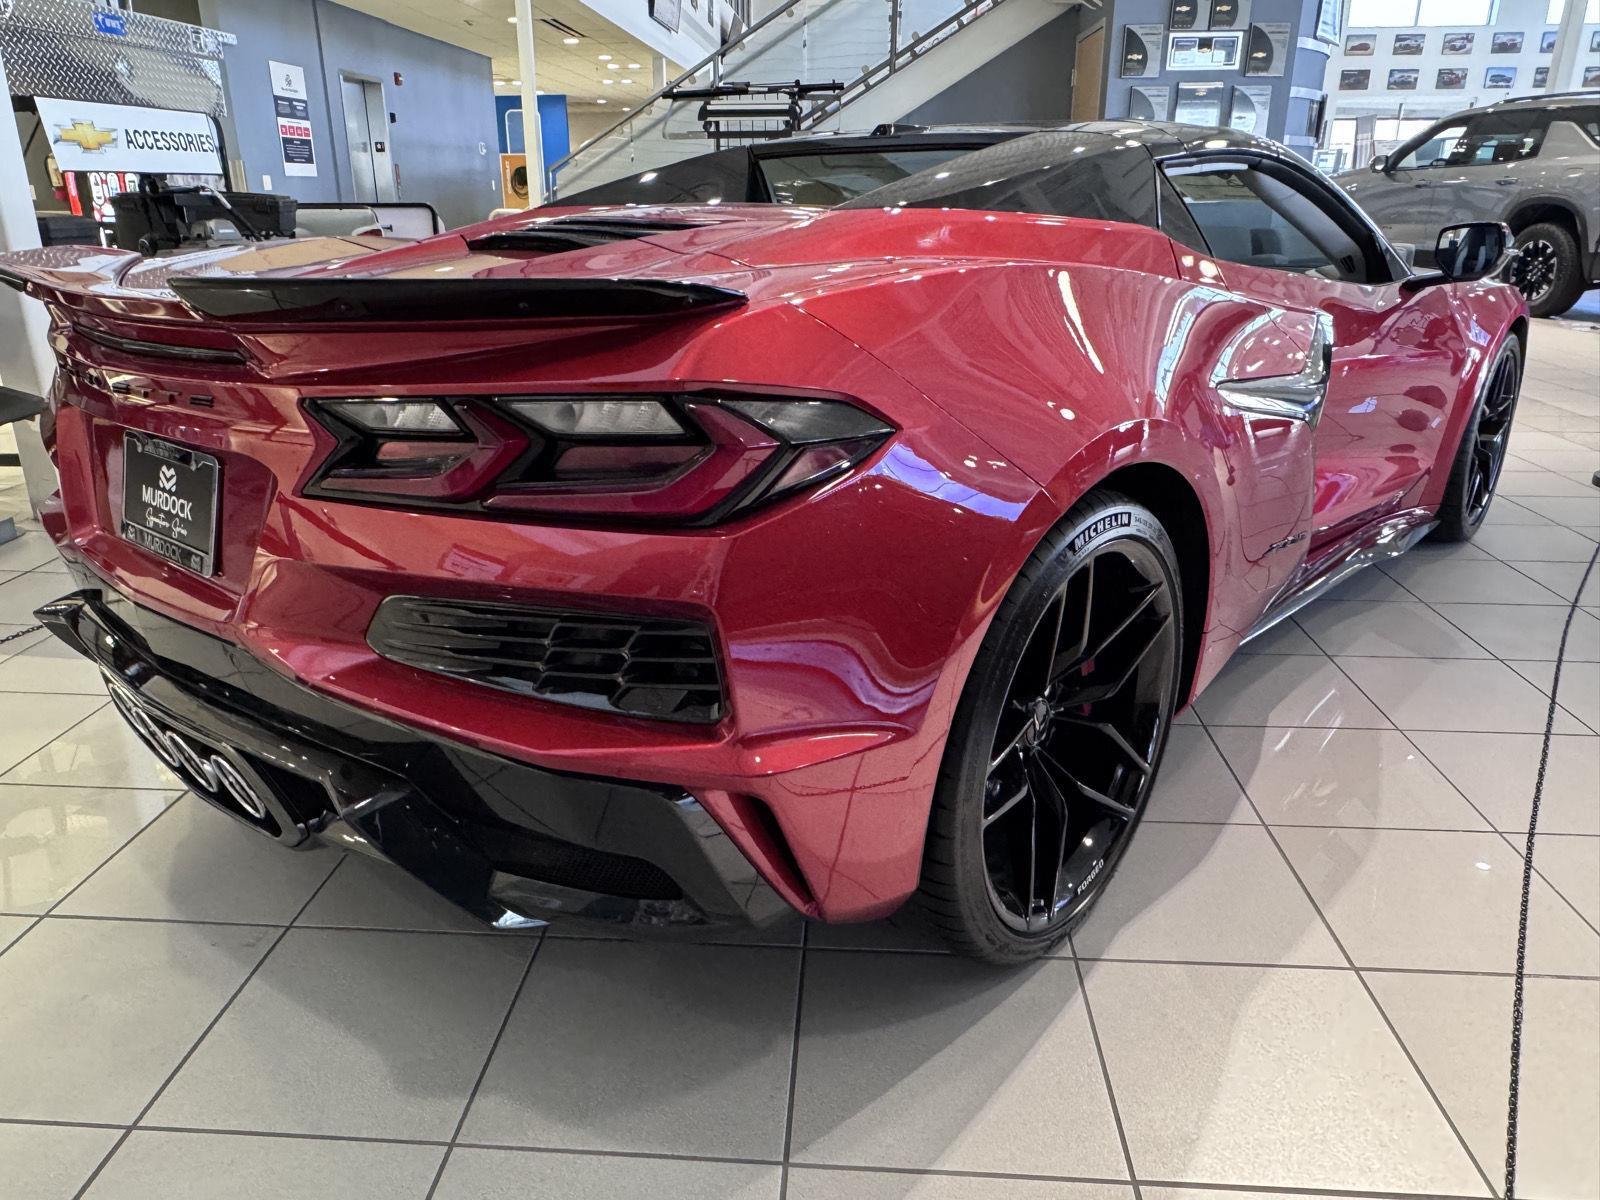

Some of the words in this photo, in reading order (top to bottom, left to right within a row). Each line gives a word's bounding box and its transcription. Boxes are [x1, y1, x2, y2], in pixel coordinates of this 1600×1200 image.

[125, 128, 215, 153] ACCESSORIES
[142, 484, 192, 521] MURDOCK
[1074, 513, 1129, 551] MICHELIN
